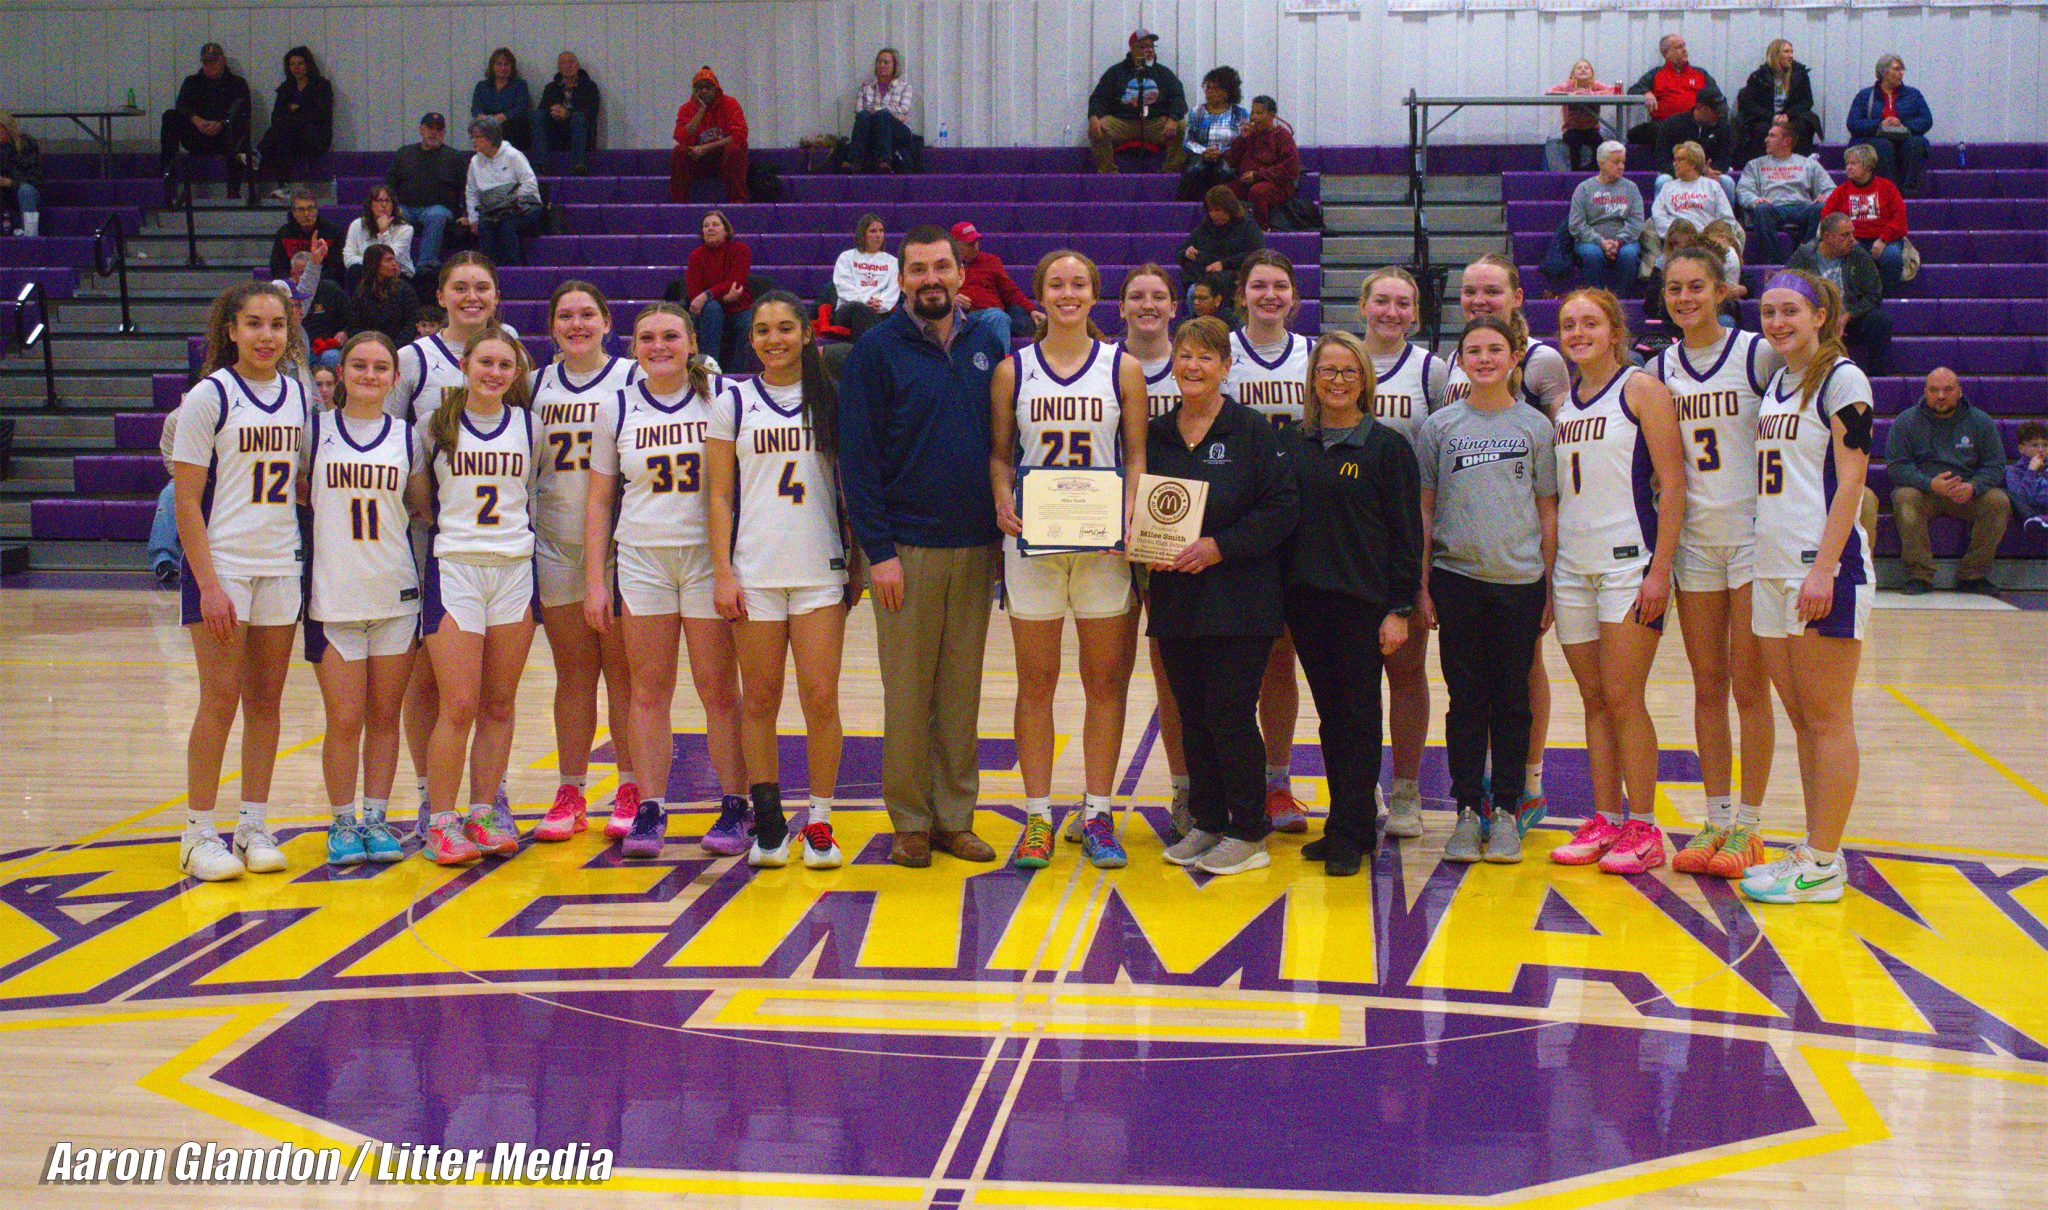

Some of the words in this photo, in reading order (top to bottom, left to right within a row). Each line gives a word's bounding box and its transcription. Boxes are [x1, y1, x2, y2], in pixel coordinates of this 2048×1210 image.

[853, 261, 889, 271] INDIANS
[1239, 380, 1305, 405] UNIOTO
[1030, 396, 1104, 423] UNIOTO
[239, 425, 302, 452] UNIOTO
[635, 421, 708, 449] UNIOTO
[754, 426, 818, 454] UNIOT
[1041, 430, 1092, 467] 25
[1446, 436, 1526, 455] Stingrays
[548, 429, 593, 473] 23
[1462, 453, 1500, 467] OHIO
[1693, 427, 1721, 472] 3
[327, 463, 399, 491] UNIOTO
[451, 451, 523, 477] UNIOTO
[646, 451, 702, 495] 33
[1571, 451, 1582, 496] 1
[1757, 449, 1784, 496] 15
[251, 460, 291, 506] 12
[778, 460, 806, 505] 4
[476, 484, 500, 526] 2
[350, 497, 380, 542] 11
[1140, 530, 1162, 539] Milee
[1162, 533, 1186, 542] Smith
